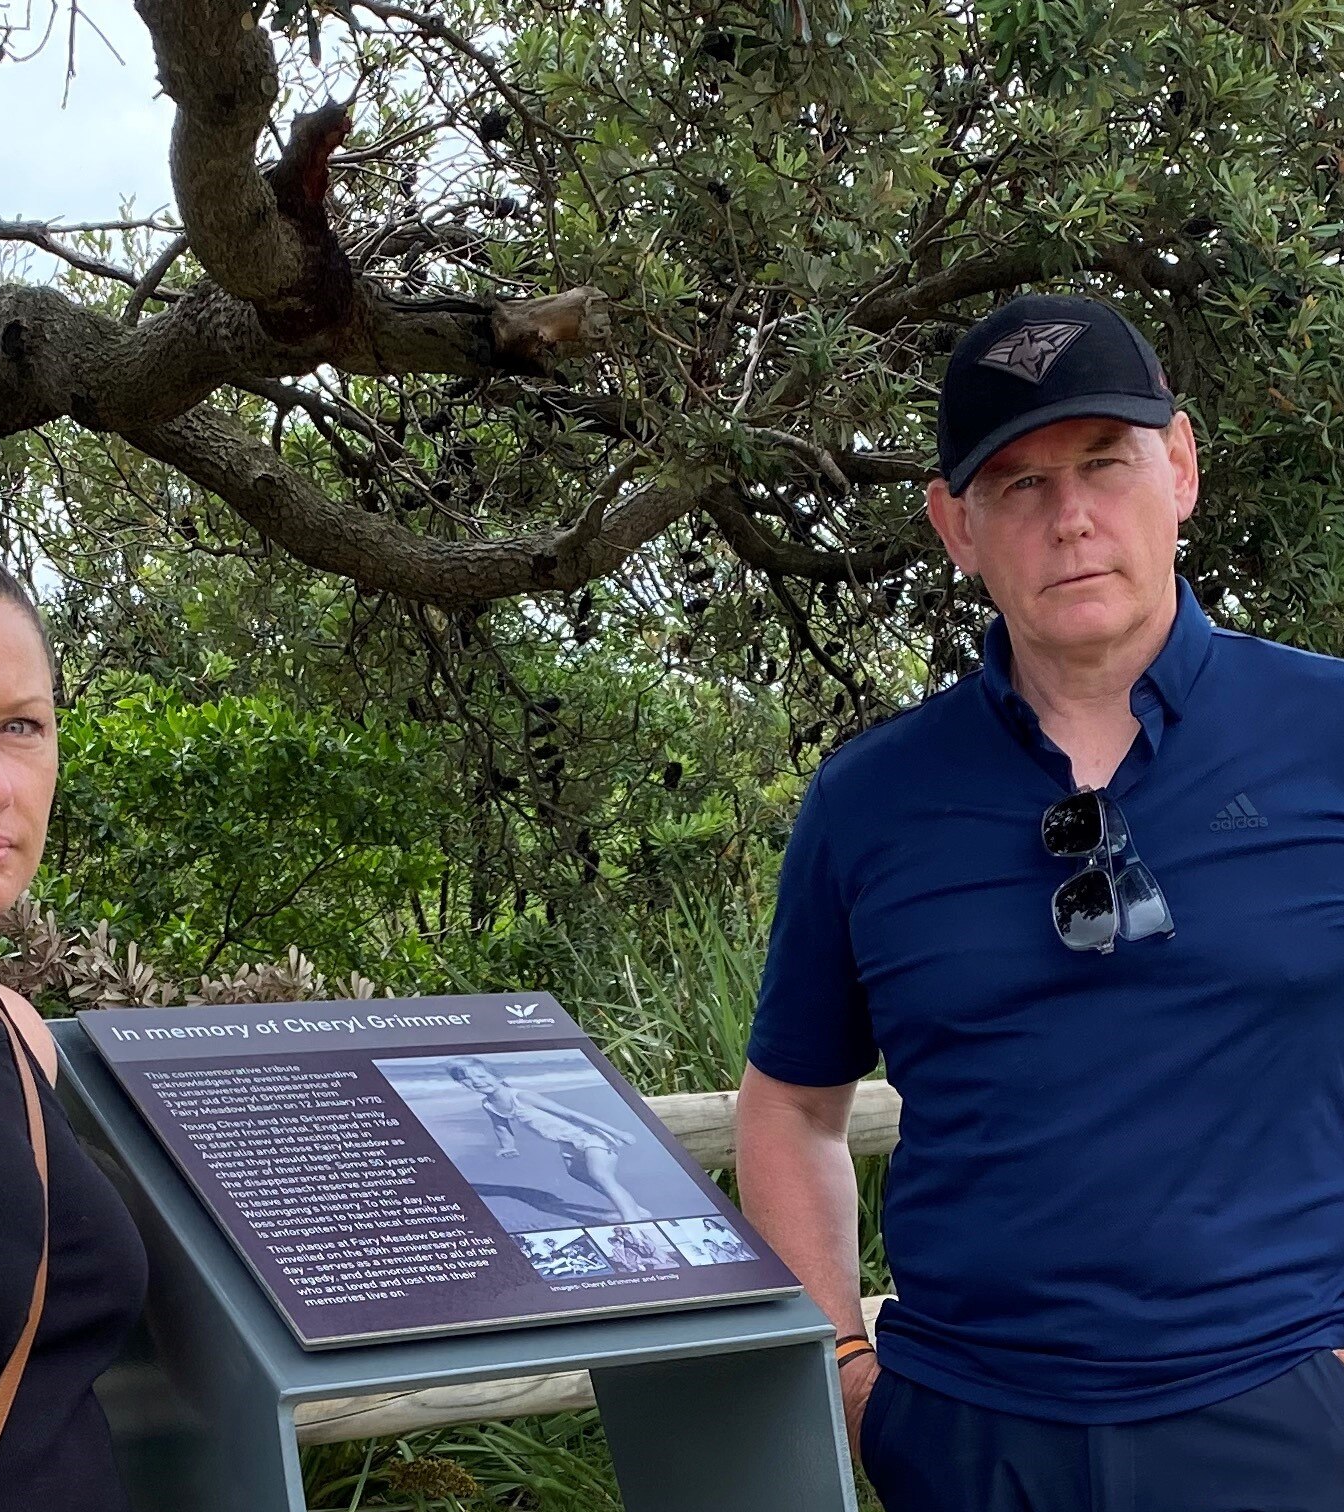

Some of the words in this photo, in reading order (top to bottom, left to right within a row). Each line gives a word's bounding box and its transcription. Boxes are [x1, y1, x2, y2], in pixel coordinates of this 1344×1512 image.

[1210, 817, 1269, 831] adidas
[111, 1026, 141, 1041] In
[144, 1024, 250, 1040] memory
[255, 1019, 280, 1034] of
[282, 1015, 367, 1034] Cheryl
[366, 1013, 472, 1029] Grimmer
[143, 1071, 171, 1080] This
[171, 1067, 262, 1079] commemorative
[262, 1064, 301, 1074] tribute
[151, 1078, 232, 1090] acknowledges
[231, 1076, 252, 1085] the
[253, 1074, 291, 1083] events
[290, 1070, 359, 1081] surrounding
[156, 1090, 178, 1099] the
[178, 1085, 249, 1098] unanswered
[249, 1082, 330, 1095] disappearance
[330, 1079, 342, 1088] of
[163, 1099, 173, 1108] 3
[173, 1099, 202, 1110] year
[201, 1097, 221, 1106] old
[220, 1094, 260, 1107] Cheryl
[259, 1092, 310, 1102] Grimmer
[311, 1090, 340, 1099] from
[169, 1108, 199, 1118] Fairy
[199, 1105, 247, 1115] Meadow
[246, 1102, 284, 1112] Beach
[283, 1102, 299, 1110] on
[298, 1100, 314, 1109] 12
[314, 1098, 356, 1108] January
[178, 1122, 218, 1131] Young
[216, 1118, 257, 1130] Cheryl
[256, 1117, 280, 1126] and
[278, 1116, 300, 1125] the
[299, 1113, 350, 1123] Grimmer
[350, 1110, 386, 1120] family
[187, 1129, 241, 1142] migrated
[240, 1128, 271, 1137] from
[269, 1124, 314, 1135] Bristol,
[312, 1120, 361, 1133] England
[359, 1121, 373, 1129] in
[372, 1118, 400, 1128] 1968
[193, 1142, 208, 1151] to
[208, 1140, 238, 1149] start
[247, 1138, 272, 1147] new
[273, 1135, 296, 1145] and
[296, 1133, 342, 1145] exciting
[339, 1131, 360, 1140] life
[201, 1148, 255, 1160] Australia
[255, 1146, 279, 1156] and
[278, 1145, 314, 1154] chose
[312, 1142, 343, 1152] Fairy
[342, 1139, 390, 1149] Meadow
[390, 1138, 406, 1146] as
[207, 1160, 246, 1170] where
[244, 1158, 272, 1168] they
[271, 1154, 309, 1165] would
[307, 1152, 342, 1163] begin
[340, 1150, 362, 1159] the
[361, 1148, 388, 1158] next
[215, 1169, 260, 1182] chapter
[261, 1166, 274, 1176] of
[274, 1164, 302, 1175] their
[334, 1161, 369, 1170] Some
[367, 1158, 385, 1167] 50
[384, 1157, 417, 1168] years
[416, 1156, 436, 1164] on,
[220, 1180, 243, 1189] the
[243, 1174, 327, 1189] disappearance
[327, 1171, 340, 1181] of
[340, 1170, 361, 1180] the
[360, 1168, 397, 1180] young
[396, 1165, 418, 1177] girl
[227, 1190, 259, 1199] from
[258, 1187, 280, 1197] the
[278, 1184, 316, 1195] beach
[316, 1182, 361, 1192] reserve
[360, 1177, 416, 1188] continues
[234, 1200, 249, 1209] to
[248, 1198, 282, 1208] leave
[282, 1197, 299, 1205] an
[297, 1191, 349, 1203] indelible
[349, 1188, 382, 1199] mark
[381, 1188, 398, 1197] on
[362, 1199, 379, 1208] To
[378, 1197, 403, 1207] this
[402, 1196, 428, 1207] day,
[425, 1194, 446, 1203] her
[248, 1220, 276, 1229] loss
[276, 1215, 334, 1227] continues
[332, 1213, 347, 1222] to
[346, 1209, 382, 1220] haunt
[380, 1208, 402, 1217] her
[402, 1204, 439, 1215] family
[438, 1202, 462, 1212] and
[256, 1231, 270, 1239] is
[269, 1225, 339, 1238] unforgotten
[337, 1223, 354, 1233] by
[353, 1221, 375, 1231] the
[373, 1217, 405, 1229] local
[265, 1244, 295, 1255] This
[295, 1241, 336, 1254] plaque
[336, 1239, 351, 1248] at
[349, 1236, 380, 1249] Fairy
[379, 1232, 429, 1244] Meadow
[428, 1228, 467, 1240] Beach
[274, 1251, 326, 1265] unveiled
[326, 1252, 343, 1260] on
[342, 1249, 364, 1258] the
[362, 1246, 391, 1256] 50th
[391, 1241, 458, 1254] anniversary
[458, 1237, 471, 1247] of
[470, 1236, 496, 1246] that
[282, 1266, 304, 1276] day
[314, 1261, 356, 1272] serves
[355, 1260, 372, 1268] as
[380, 1253, 434, 1266] reminder
[434, 1252, 449, 1260] to
[448, 1249, 466, 1259] all
[465, 1247, 478, 1257] of
[477, 1246, 498, 1256] the
[288, 1273, 340, 1288] tragedy,
[339, 1270, 364, 1281] and
[363, 1263, 444, 1278] demonstrates
[442, 1261, 457, 1270] to
[456, 1259, 490, 1269] those
[296, 1286, 324, 1296] who
[324, 1284, 346, 1294] are
[344, 1279, 379, 1291] loved
[378, 1277, 402, 1288] and
[400, 1275, 426, 1286] lost
[424, 1273, 451, 1283] that
[449, 1269, 477, 1281] their
[304, 1293, 366, 1307] memories
[364, 1291, 389, 1301] live
